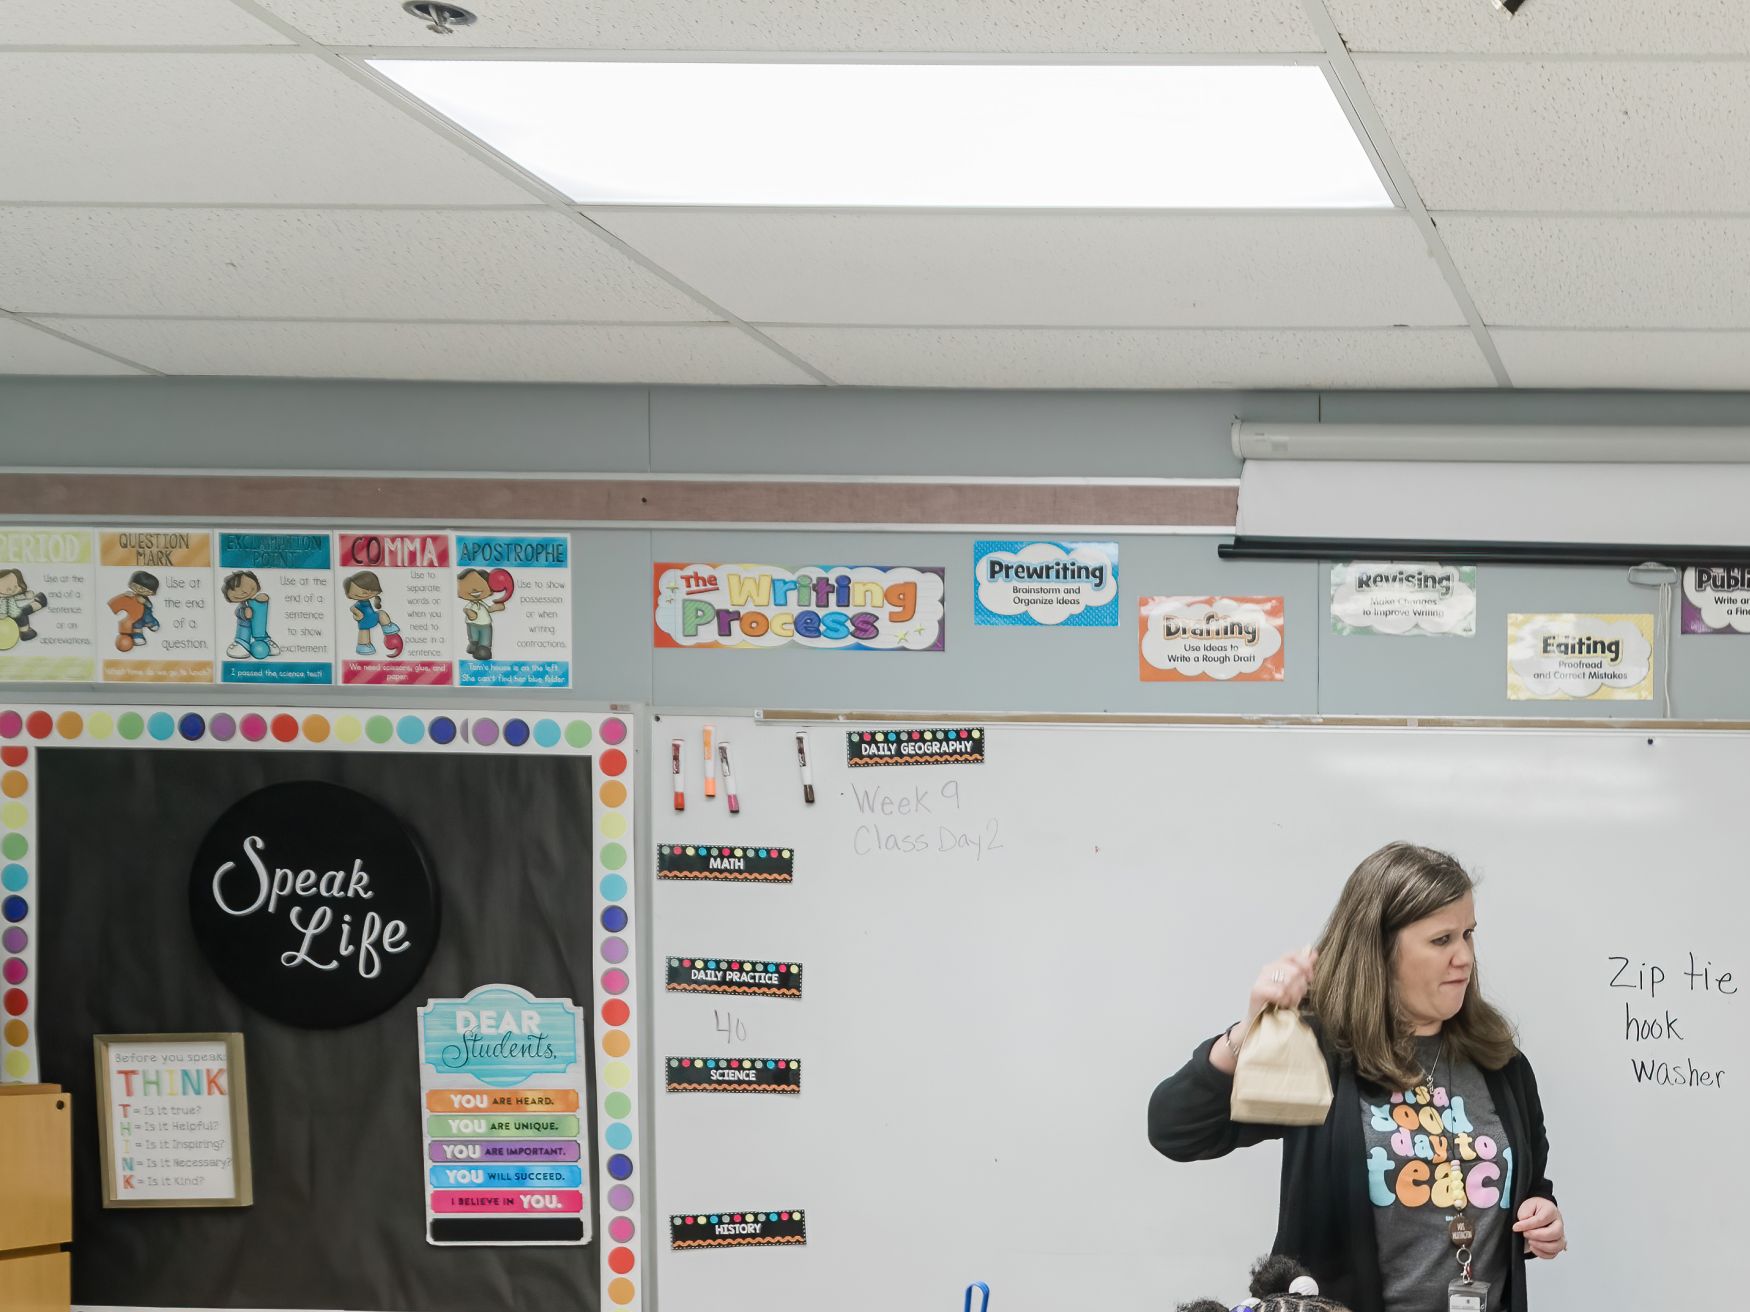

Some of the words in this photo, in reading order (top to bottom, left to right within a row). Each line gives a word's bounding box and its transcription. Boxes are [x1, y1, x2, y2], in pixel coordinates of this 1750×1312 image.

[119, 533, 189, 549] QUESTION
[136, 551, 173, 566] MARK
[352, 536, 438, 566] COMMA
[461, 543, 564, 563] APOSTROPHE
[989, 560, 1105, 587] Prewriting
[680, 571, 718, 589] The
[726, 573, 917, 622] Writing
[1013, 586, 1060, 595] Brainstorm
[1063, 586, 1080, 594] and
[1013, 597, 1053, 606] Organize
[1056, 597, 1080, 605] Ideas
[1715, 596, 1737, 605] Write
[682, 599, 879, 640] Process
[1727, 608, 1732, 616] a
[1165, 613, 1257, 644] Drafting
[1184, 644, 1200, 652] Use
[1203, 644, 1227, 652] Ideas
[1167, 654, 1191, 663] Write
[1202, 654, 1230, 664] Rough
[1234, 654, 1255, 663] Draft
[1558, 660, 1603, 668] Proofread
[1534, 671, 1550, 679] and
[1554, 671, 1585, 679] Correct
[1588, 671, 1628, 679] Mistakes
[861, 742, 897, 755] DAILY
[901, 740, 973, 755] GEOGRAPHY
[852, 783, 931, 817] Week
[941, 780, 960, 809] 9
[854, 823, 928, 855] Class
[709, 857, 744, 870] MATH
[213, 836, 374, 916] Speak
[281, 906, 411, 979] Life
[691, 969, 723, 982] DAILY
[726, 971, 779, 984] PRACTICE
[1609, 957, 1665, 998] Zip
[1684, 952, 1737, 994] tie
[456, 1010, 541, 1034] DEAR
[714, 1008, 747, 1043] 40
[1626, 1002, 1683, 1041] hook
[442, 1025, 557, 1068] Students,
[116, 1068, 228, 1096] THINK
[710, 1069, 756, 1081] SCIENCE
[450, 1094, 488, 1108] YOU
[516, 1097, 555, 1105] HEARD.
[448, 1119, 486, 1133] YOU
[490, 1122, 510, 1130] ARE
[514, 1122, 558, 1131] UNIQUE.
[443, 1144, 481, 1159] YOU
[485, 1148, 504, 1156] ARE
[506, 1147, 566, 1156] IMPORTANT.
[1391, 1127, 1448, 1163] day
[1455, 1133, 1497, 1160] to
[446, 1170, 484, 1184] YOU
[488, 1172, 511, 1181] WILL
[514, 1172, 565, 1181] SUCCEED.
[458, 1197, 499, 1206] BELIEVE
[503, 1197, 514, 1206] IN
[520, 1194, 562, 1208] YOU.
[715, 1222, 762, 1236] HISTORY
